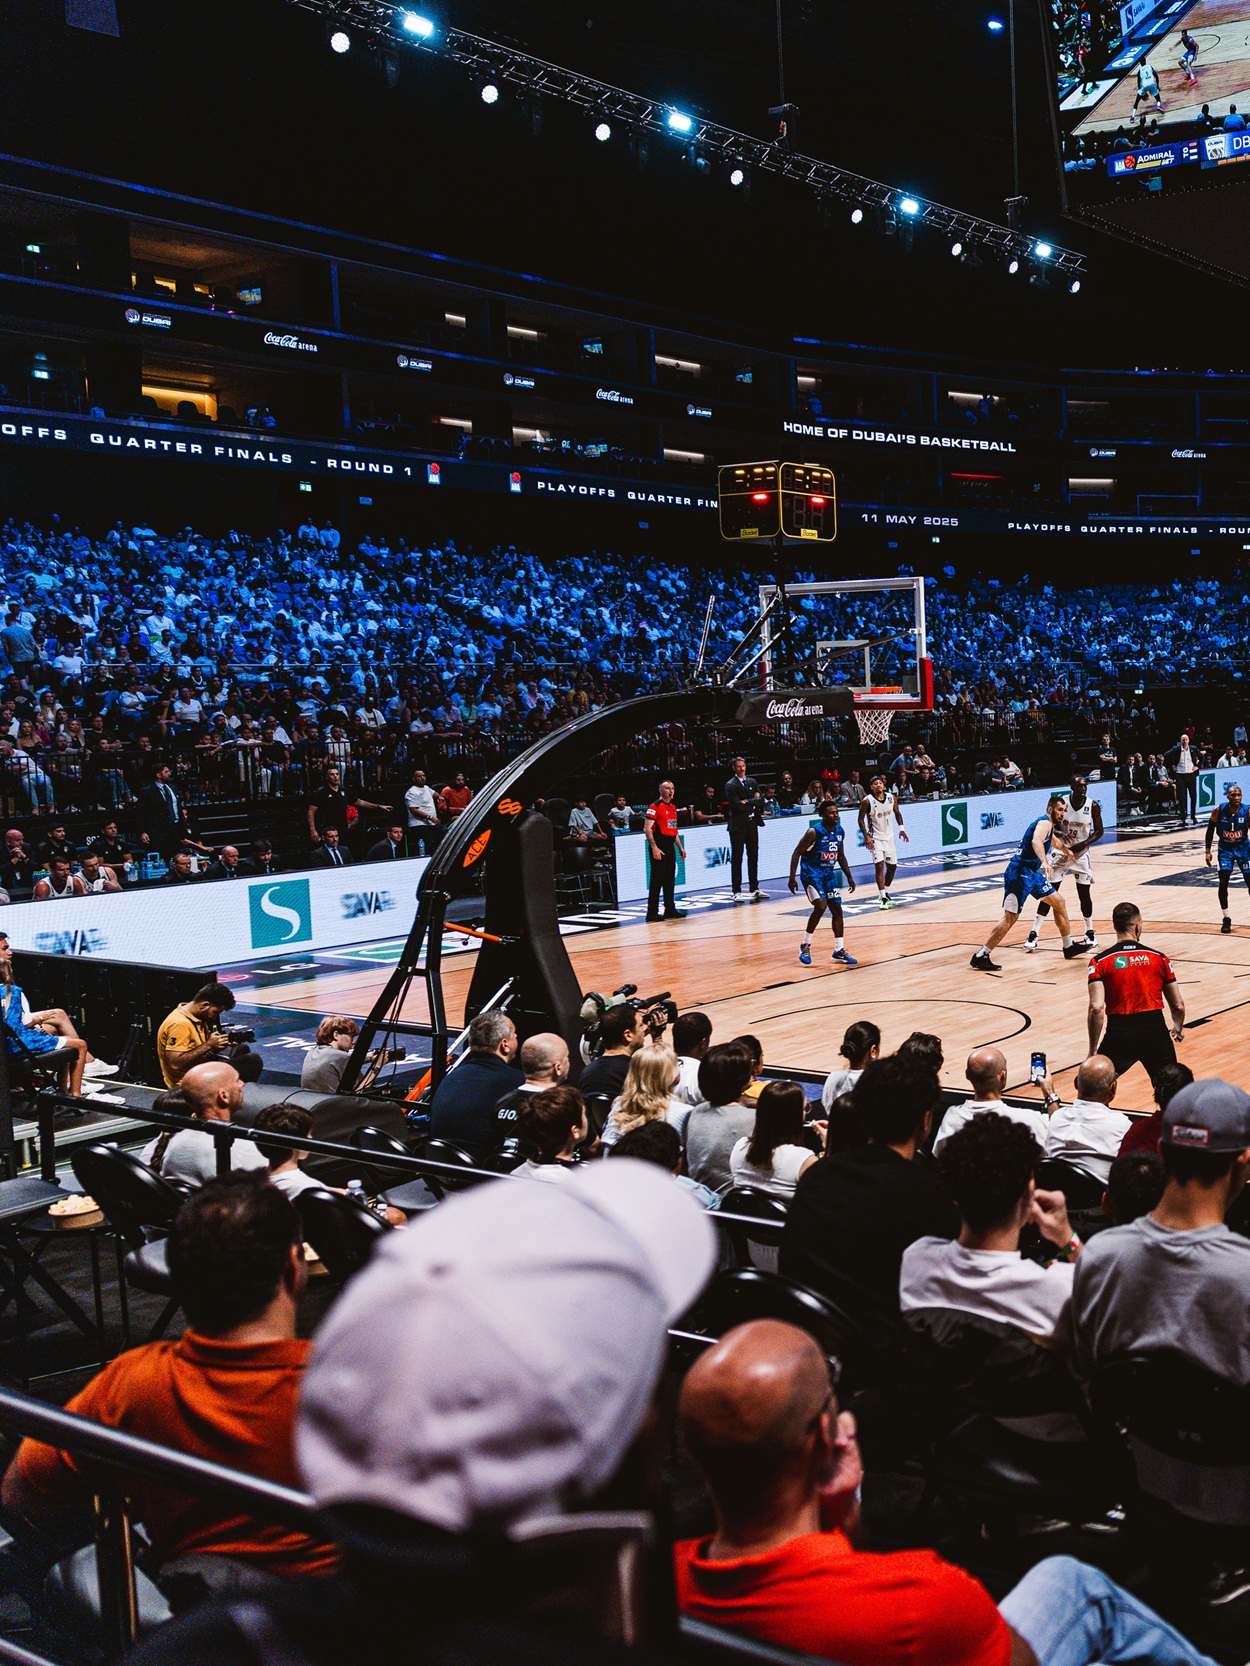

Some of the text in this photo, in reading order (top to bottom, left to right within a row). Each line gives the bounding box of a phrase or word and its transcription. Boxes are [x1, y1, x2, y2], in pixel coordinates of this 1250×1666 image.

[1137, 150, 1174, 164] ADMIRAL
[1183, 147, 1189, 158] TO
[142, 316, 171, 326] DUBAI
[264, 332, 318, 352] Coca-Cola arena
[596, 388, 620, 402] Coca-Cola
[784, 422, 1016, 452] HOME OF DUBAI'S BASKETBALL
[2, 424, 410, 475] OFFS QUARTER FINALS ROUND 1
[1171, 449, 1194, 458] Coca-Cola
[538, 482, 717, 507] PLAYOFFS QUARTER FIN
[862, 514, 958, 526] 11 MAY 2025
[1008, 523, 1070, 531] PLAYOFFS
[766, 698, 824, 718] Coca-Cola arena
[1231, 822, 1234, 831] 1
[468, 835, 486, 860] ACE
[829, 841, 838, 852] 25
[842, 877, 1005, 913] ADMIRA
[251, 962, 321, 975] LG
[170, 1037, 176, 1046] 3
[498, 1109, 518, 1120] GJO
